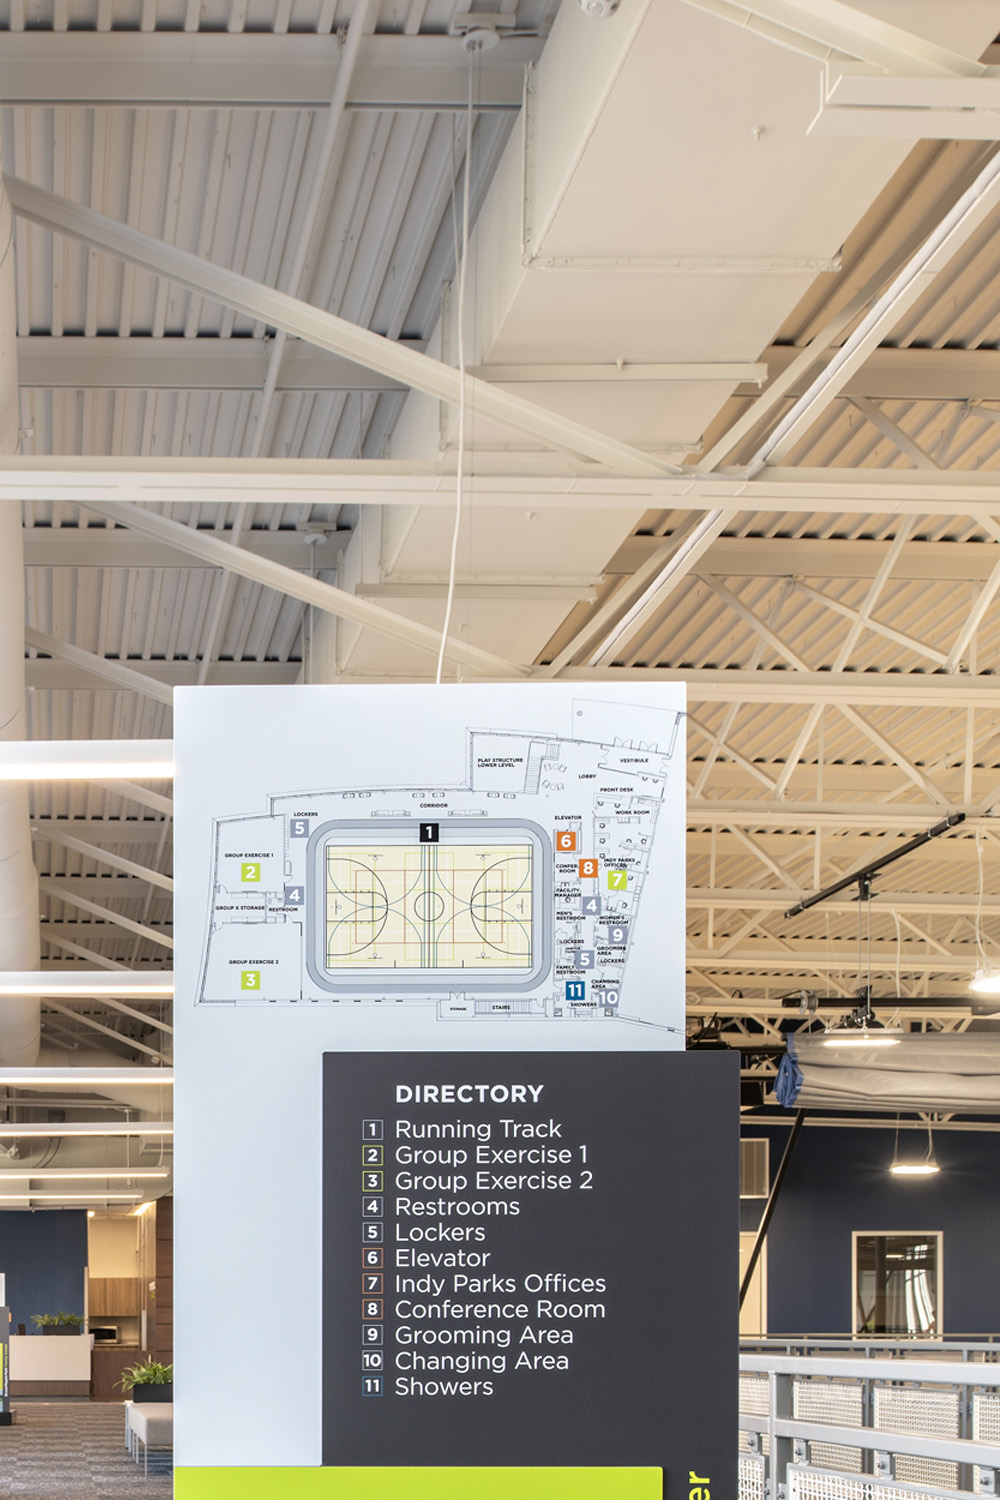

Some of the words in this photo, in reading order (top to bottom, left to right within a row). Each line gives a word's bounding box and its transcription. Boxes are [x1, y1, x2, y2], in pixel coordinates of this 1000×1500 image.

[295, 821, 304, 835] 5
[425, 825, 433, 839] 1
[561, 834, 572, 848] 6
[246, 865, 256, 879] 2
[583, 861, 594, 875] 8
[612, 873, 623, 887] 7
[289, 889, 300, 902] 4
[586, 899, 597, 912] 4
[613, 928, 623, 942] 9
[580, 952, 590, 966] 5
[246, 974, 256, 987] 3
[568, 984, 582, 997] 11
[600, 991, 618, 1005] 10
[396, 1085, 544, 1103] DIRECTORY
[370, 1123, 375, 1135] 1
[396, 1120, 490, 1141] Running
[500, 1119, 561, 1138] Track
[368, 1149, 377, 1161] 2
[396, 1146, 467, 1167] Group
[477, 1145, 572, 1163] Exercise
[580, 1145, 586, 1163] 1
[368, 1175, 377, 1187] 3
[396, 1172, 467, 1193] Group
[477, 1171, 571, 1189] Exercise
[580, 1171, 592, 1189] 2
[367, 1200, 378, 1212] 4
[396, 1197, 520, 1216] Restrooms
[368, 1226, 377, 1239] 5
[396, 1222, 485, 1241] Lockers
[368, 1252, 377, 1264] 6
[396, 1248, 490, 1267] Elevator
[368, 1277, 377, 1289] 7
[396, 1274, 445, 1296] Indy
[454, 1274, 516, 1292] Parks
[525, 1273, 606, 1292] Offices
[368, 1303, 377, 1315] 8
[396, 1299, 528, 1318] Conference
[538, 1300, 605, 1318] Room
[368, 1329, 377, 1341] 9
[396, 1326, 510, 1347] Grooming
[519, 1326, 573, 1344] Area
[364, 1354, 381, 1367] 10
[396, 1351, 505, 1373] Changing
[515, 1351, 568, 1369] Area
[366, 1380, 379, 1392] 11
[395, 1377, 493, 1395] Showers
